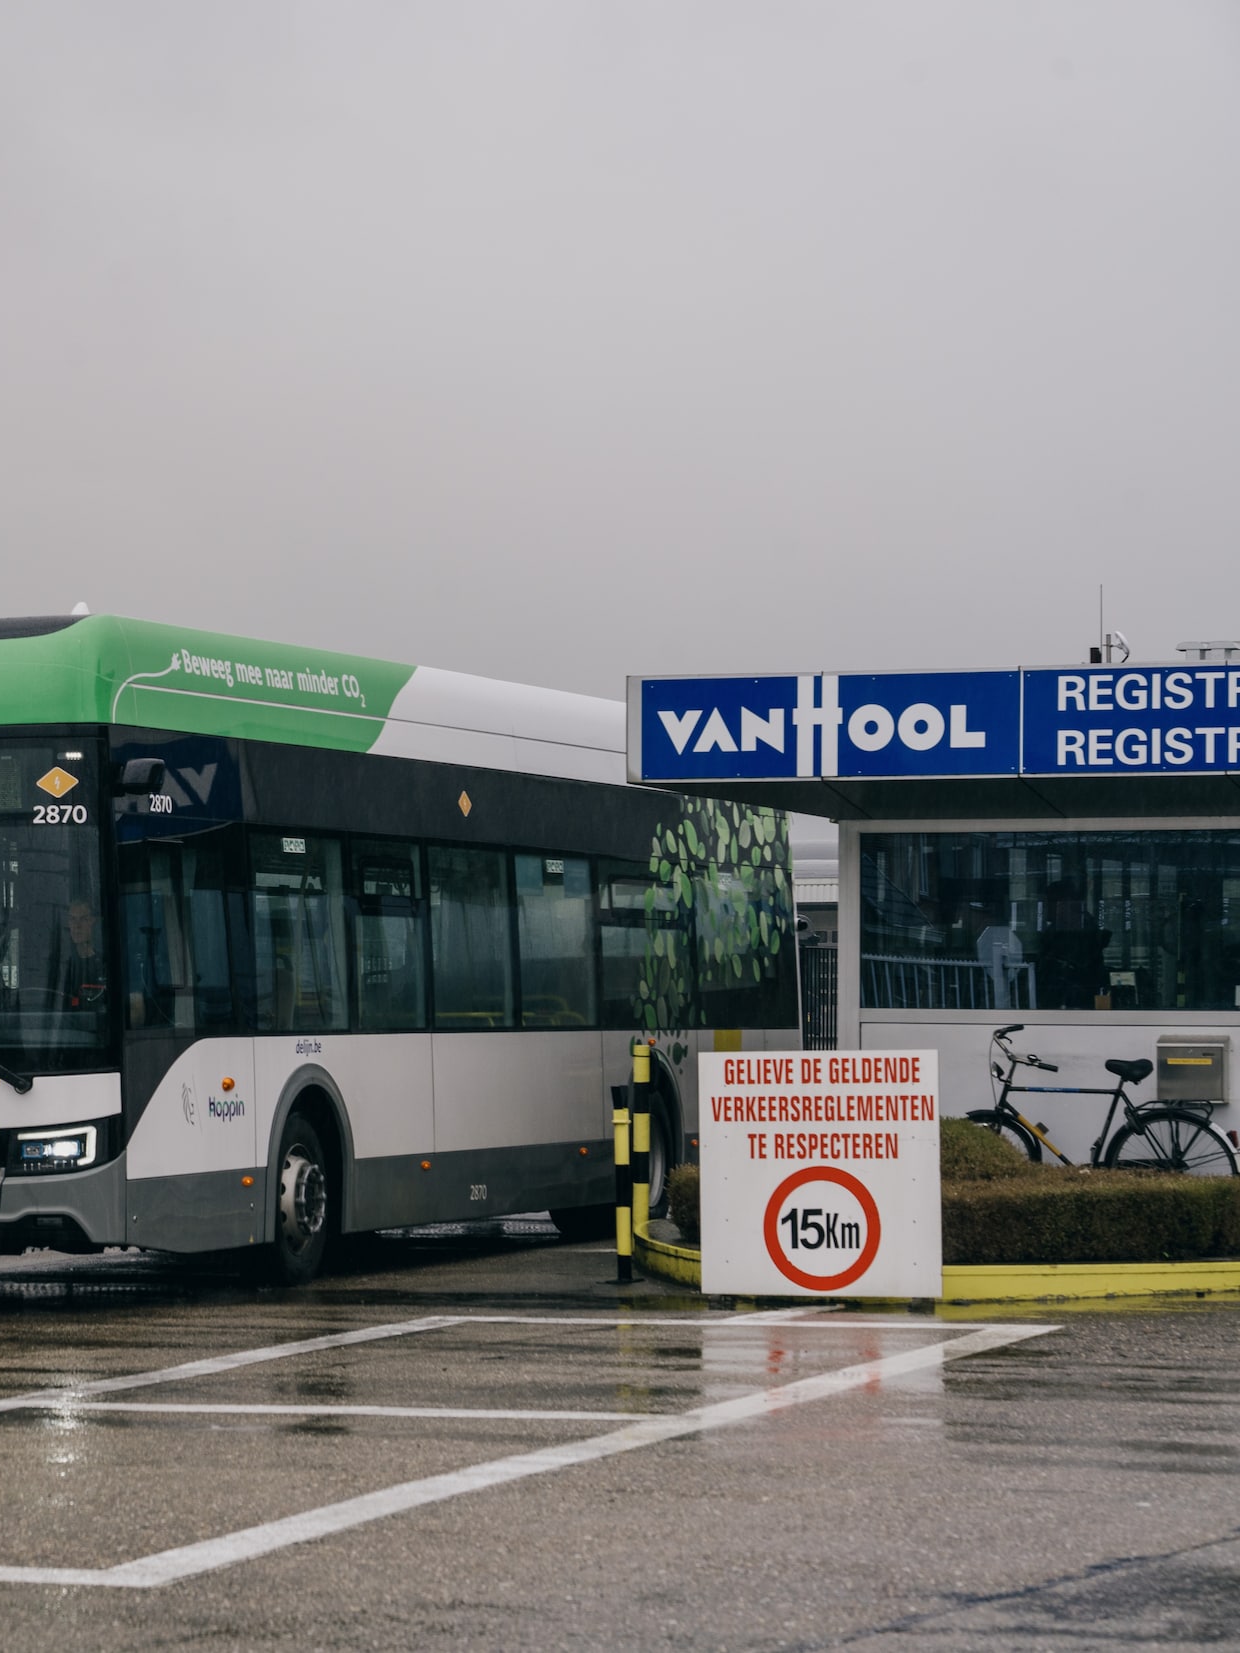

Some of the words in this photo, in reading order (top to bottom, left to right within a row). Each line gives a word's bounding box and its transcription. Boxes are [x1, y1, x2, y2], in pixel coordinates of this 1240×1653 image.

[181, 649, 234, 688] Beweeg
[235, 663, 263, 686] mee
[264, 668, 294, 690] naar
[296, 667, 339, 696] minder
[33, 805, 87, 824] 2870
[149, 794, 173, 814] 2870
[295, 1039, 322, 1056] delijn.be
[724, 1058, 793, 1085] GELIEVE
[801, 1058, 822, 1084] DE
[829, 1057, 920, 1084] GELDENDE
[208, 1093, 245, 1122] Hoppin
[711, 1095, 934, 1122] VERKEERSREGLEMENTEN
[747, 1133, 767, 1159] TE
[774, 1133, 898, 1159] RESPECTEREN
[470, 1184, 488, 1200] 2870
